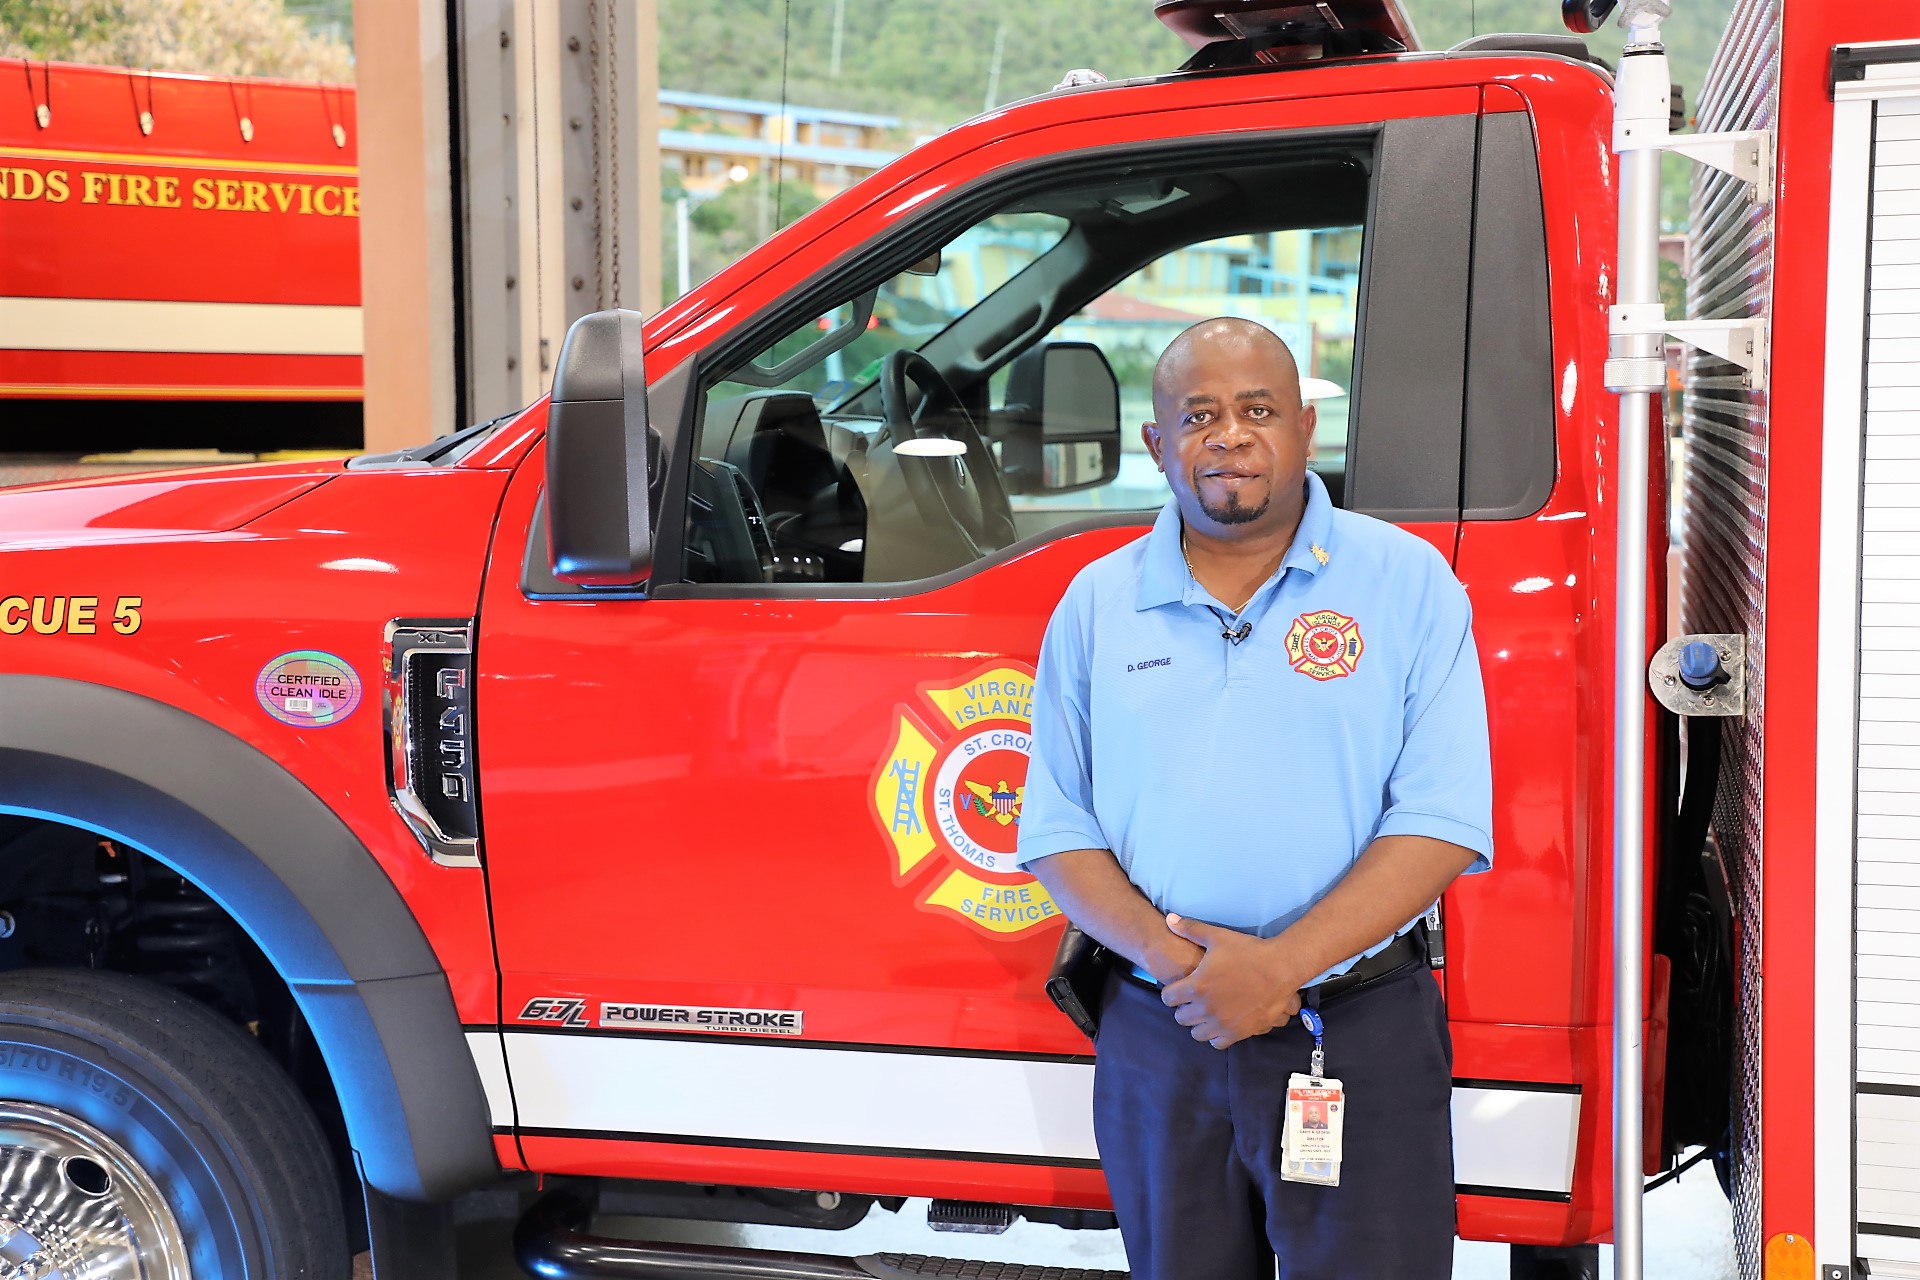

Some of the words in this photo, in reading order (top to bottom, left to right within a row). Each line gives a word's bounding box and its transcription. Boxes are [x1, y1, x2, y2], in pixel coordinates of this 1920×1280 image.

[81, 172, 182, 208] FIRE
[192, 178, 360, 217] SERVICE
[0, 595, 99, 635] CUE
[112, 596, 142, 635] 5
[418, 633, 447, 644] XL
[1127, 664, 1136, 672] D.
[1137, 657, 1171, 670] GEORGE
[277, 674, 341, 686] CERTIFIED
[271, 687, 313, 698] CLEAN
[319, 689, 347, 699] IDLE
[955, 699, 1033, 724] ISLAND
[964, 738, 987, 756] ST.
[991, 733, 1033, 754] CROI
[939, 788, 951, 811] ST.
[959, 793, 973, 810] V
[942, 814, 996, 868] THOMAS
[982, 887, 1032, 904] FIRE
[960, 898, 1055, 922] SERVICE
[522, 998, 589, 1027] 6.7L
[606, 1006, 690, 1023] POWER
[697, 1011, 795, 1027] STROKE
